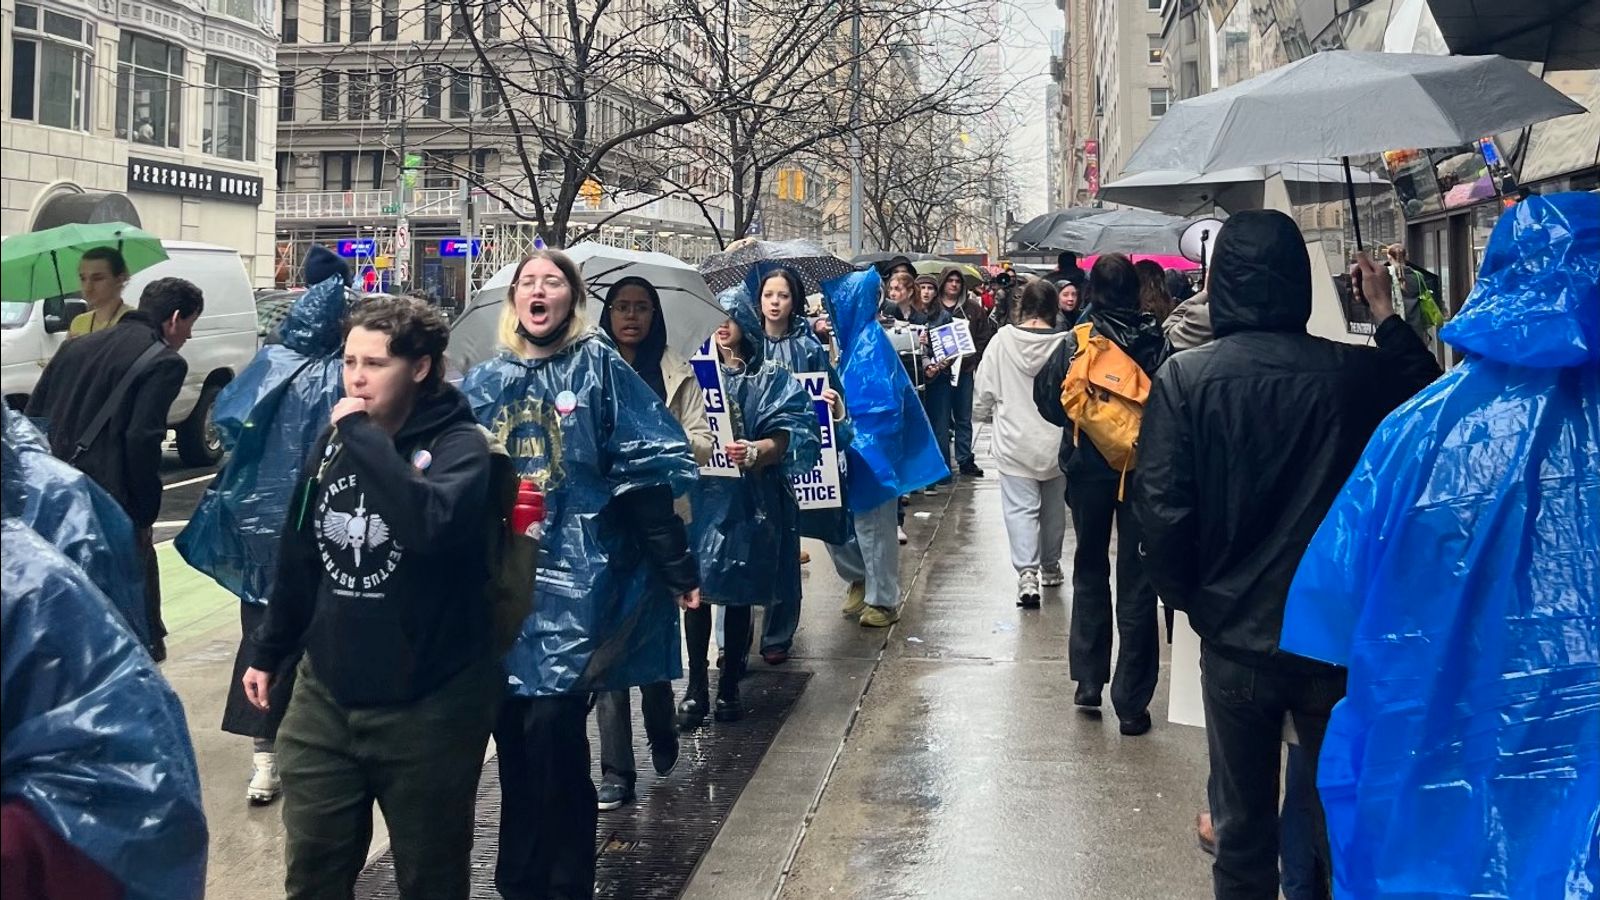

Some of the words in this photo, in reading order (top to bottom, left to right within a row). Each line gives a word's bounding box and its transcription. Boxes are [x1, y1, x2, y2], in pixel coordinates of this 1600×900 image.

[133, 164, 212, 191] PERFORMIX
[220, 177, 258, 197] HOUSE
[954, 322, 973, 352] UAW
[792, 468, 823, 485] BOR
[795, 485, 837, 502] CTICE
